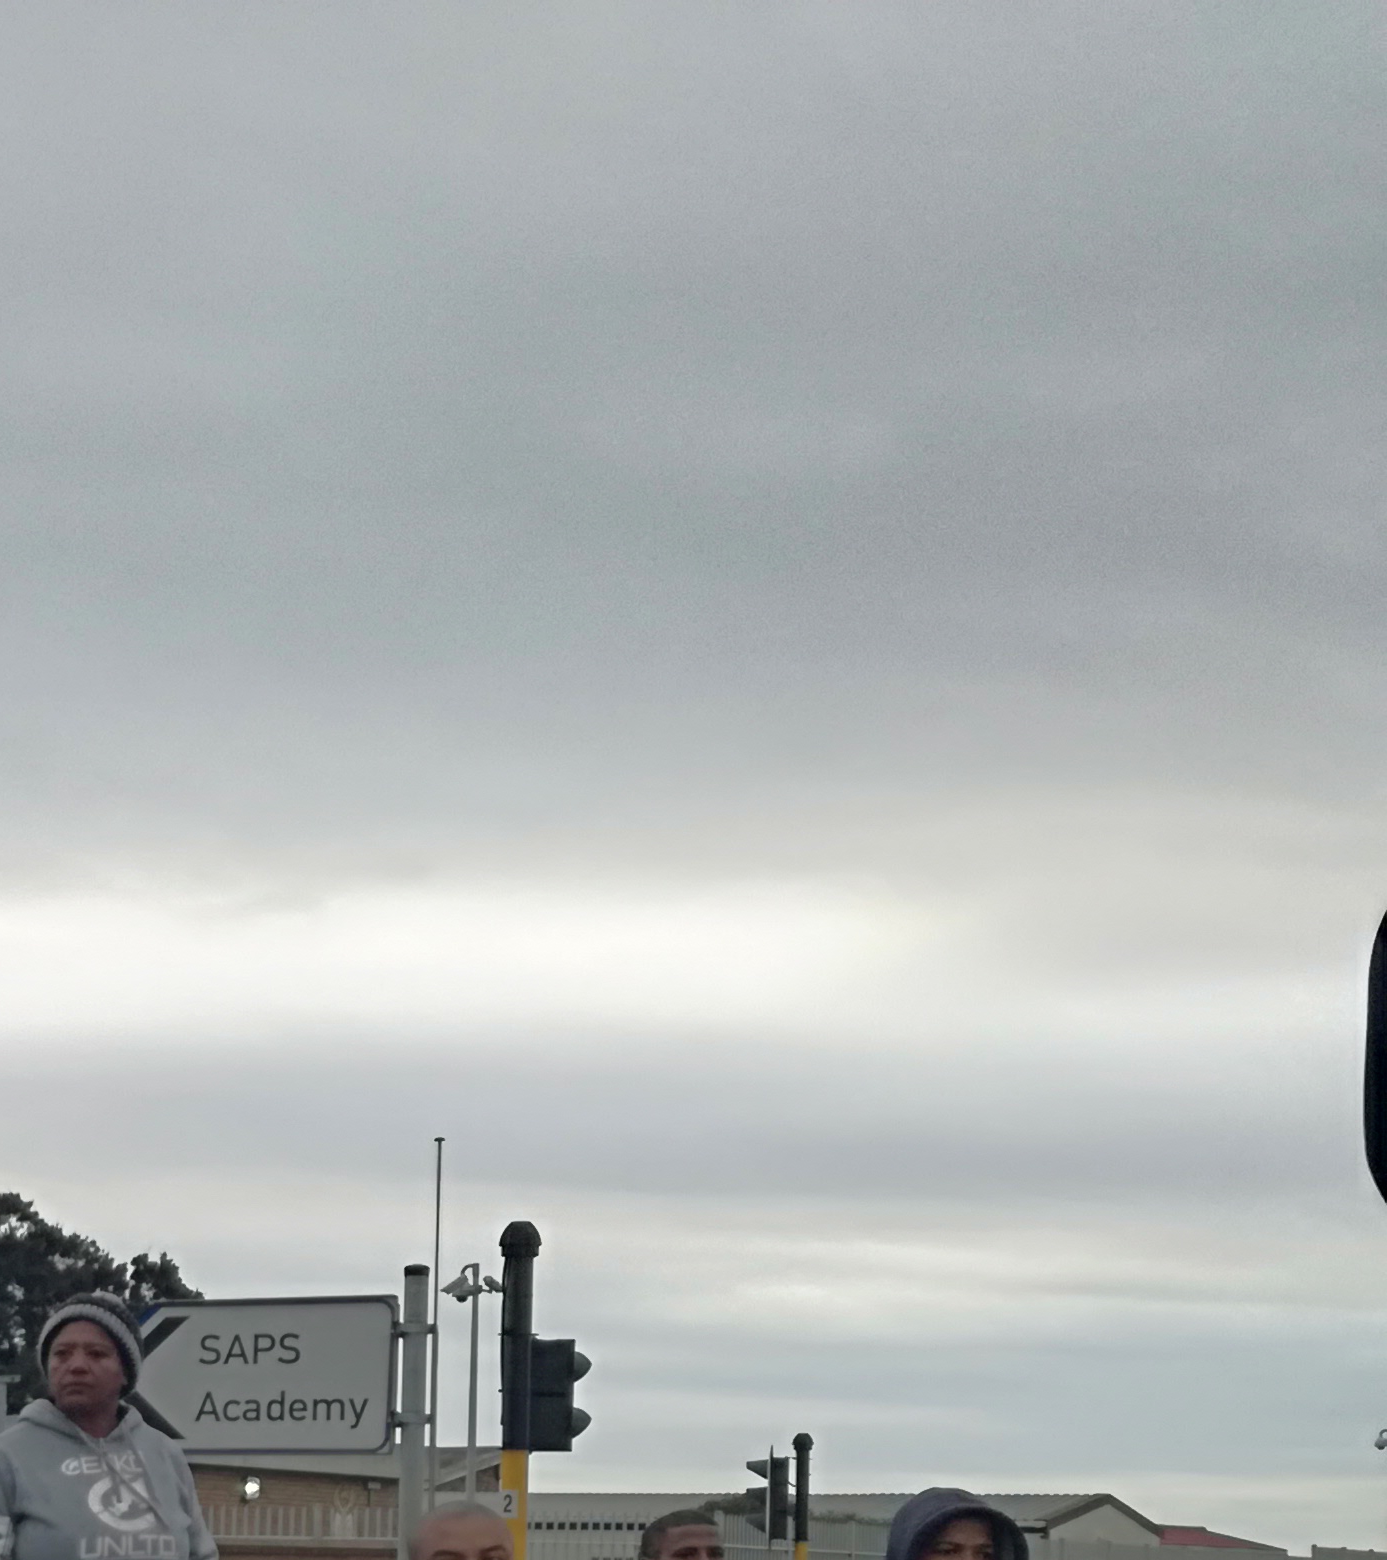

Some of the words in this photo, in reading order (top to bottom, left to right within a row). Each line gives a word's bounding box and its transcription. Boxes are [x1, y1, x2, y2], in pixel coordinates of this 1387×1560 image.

[198, 1332, 302, 1365] SAPS
[194, 1390, 370, 1430] Academy
[503, 1493, 513, 1513] 2
